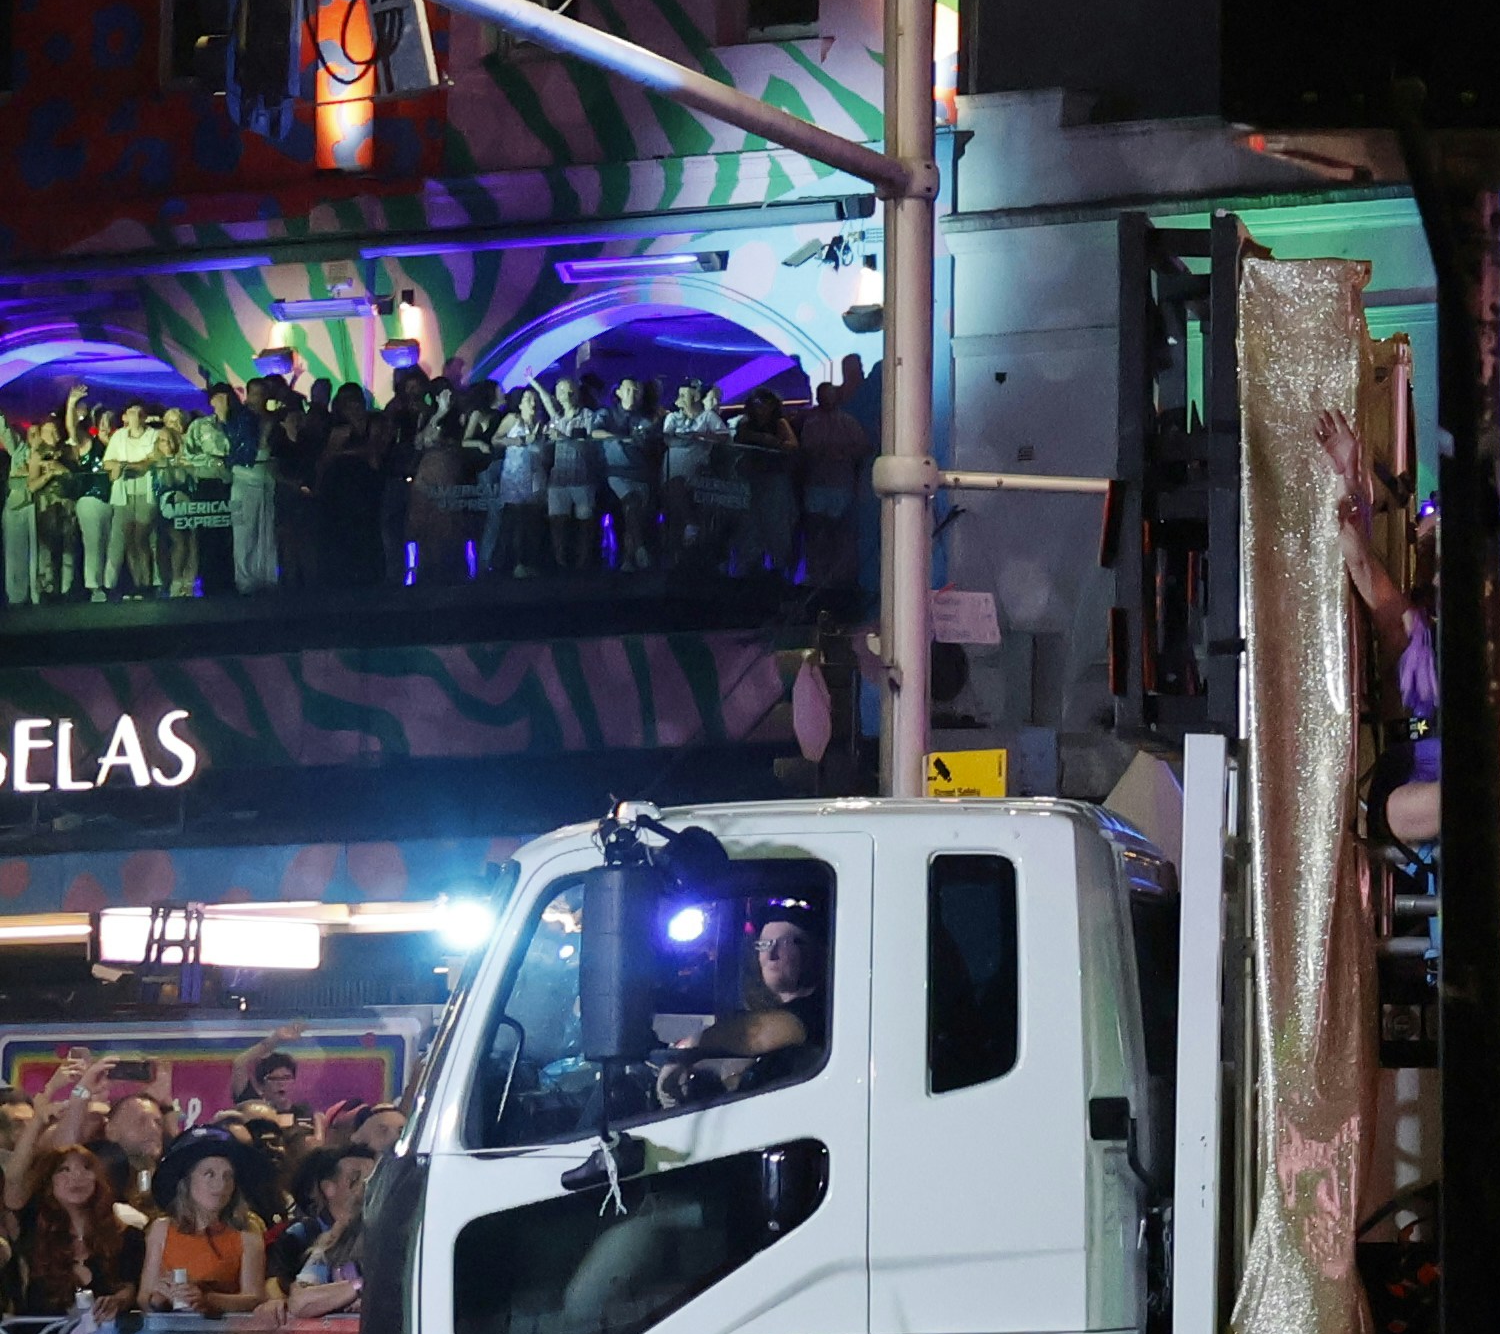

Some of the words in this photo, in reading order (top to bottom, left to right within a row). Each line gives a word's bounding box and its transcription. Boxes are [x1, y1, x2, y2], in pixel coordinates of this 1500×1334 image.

[162, 500, 231, 517] AMERICA
[174, 515, 231, 530] EXPRES
[0, 709, 197, 793] ELAS
